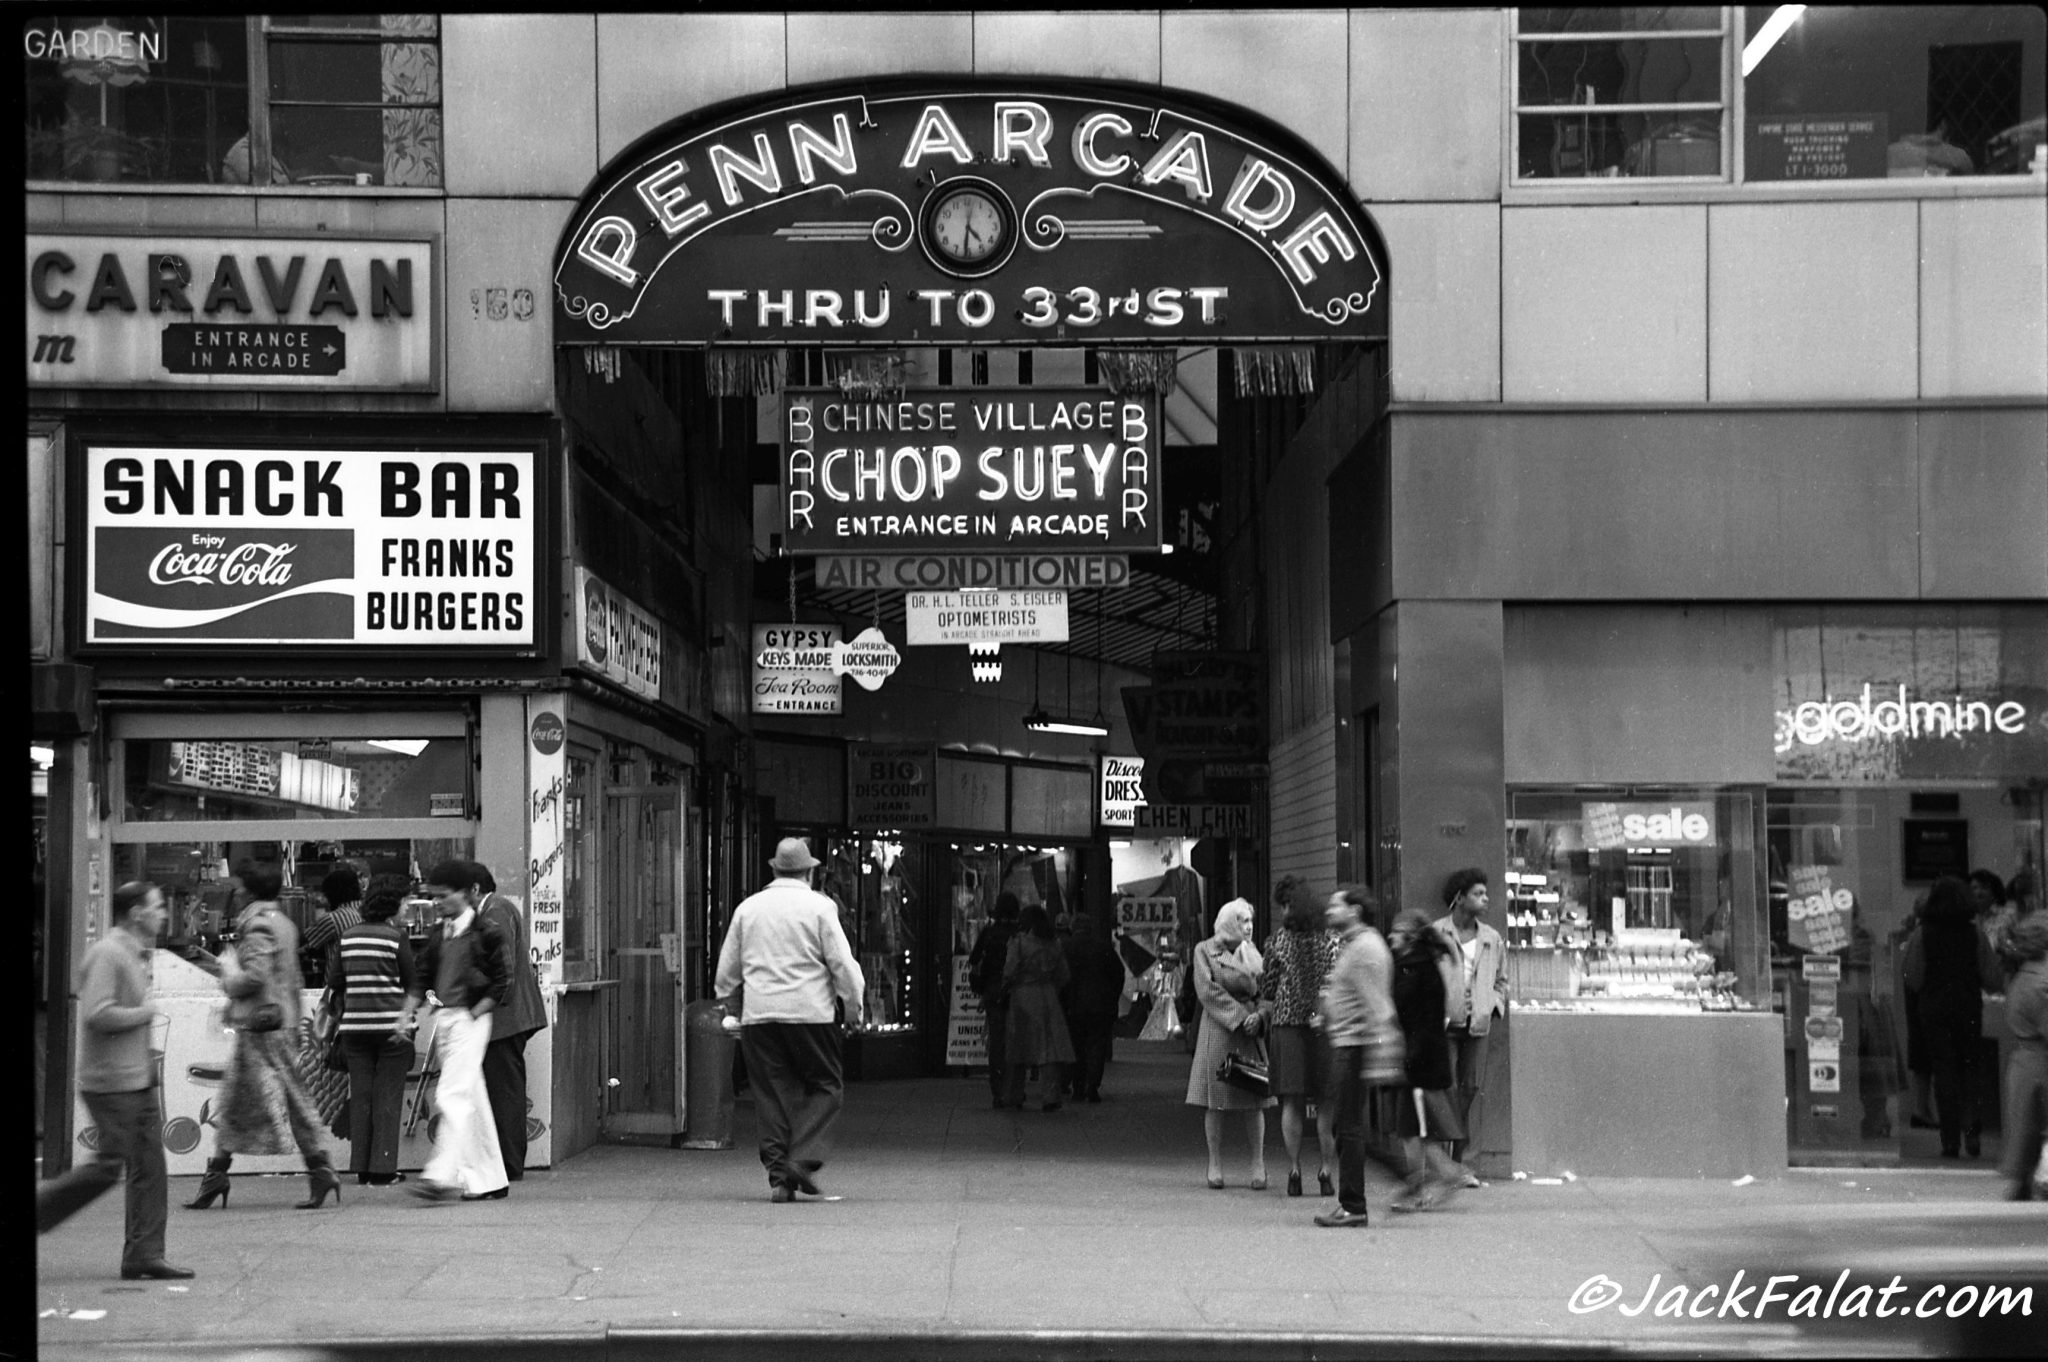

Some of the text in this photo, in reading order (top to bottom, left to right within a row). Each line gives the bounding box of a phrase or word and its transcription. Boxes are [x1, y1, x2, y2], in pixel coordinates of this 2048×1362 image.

[25, 30, 160, 60] GARDEN
[576, 99, 1362, 287] PENN ARCADE
[31, 251, 413, 318] CARAVAN
[708, 288, 893, 328] THRU
[917, 289, 995, 326] TO
[194, 331, 310, 348] ENTRANCE
[191, 352, 312, 370] IN ARCADE
[823, 401, 1116, 433] CHINESE VILLAGE
[789, 406, 815, 530] BAR
[820, 442, 1118, 502] CHOP SUEY
[1122, 405, 1148, 529] BAR
[102, 457, 521, 519] SNACK BAR
[836, 514, 1109, 540] ENTRANCE IN ARCADE
[191, 533, 226, 549] Enjoy
[149, 542, 298, 586] Coca-Cola
[381, 538, 514, 578] FRANKS
[824, 557, 1127, 587] AIR CONDITIONED
[911, 595, 929, 608] DR.
[959, 593, 999, 607] TELLER
[1010, 592, 1021, 606] S.
[1023, 591, 1062, 606] EISLER
[367, 591, 523, 631] BURGERS
[937, 610, 1037, 628] OPTOMETRISTS
[765, 629, 832, 648] GYPSY
[851, 641, 890, 651] SUPERIOR
[762, 651, 832, 666] KEYS MADE
[842, 653, 898, 667] LOCKSMITH
[755, 676, 839, 696] Tea Room
[776, 700, 836, 711] ENTRANCE
[1795, 682, 2026, 745] goldmine
[870, 762, 914, 780] BIG
[532, 775, 562, 823] Franks
[856, 783, 928, 798] DISCOUNT
[1105, 780, 1145, 801] DRES
[873, 801, 911, 811] JEANS
[1105, 809, 1135, 820] SPORT
[1139, 806, 1191, 828] CHEN
[857, 813, 929, 824] ACCESSORIES
[1623, 807, 1709, 841] sale
[531, 842, 563, 888] Burgers
[533, 902, 560, 914] FRESH
[1122, 903, 1173, 922] SALE
[1787, 887, 1853, 921] sale
[535, 921, 559, 933] FRUIT
[531, 939, 562, 962] Drnks
